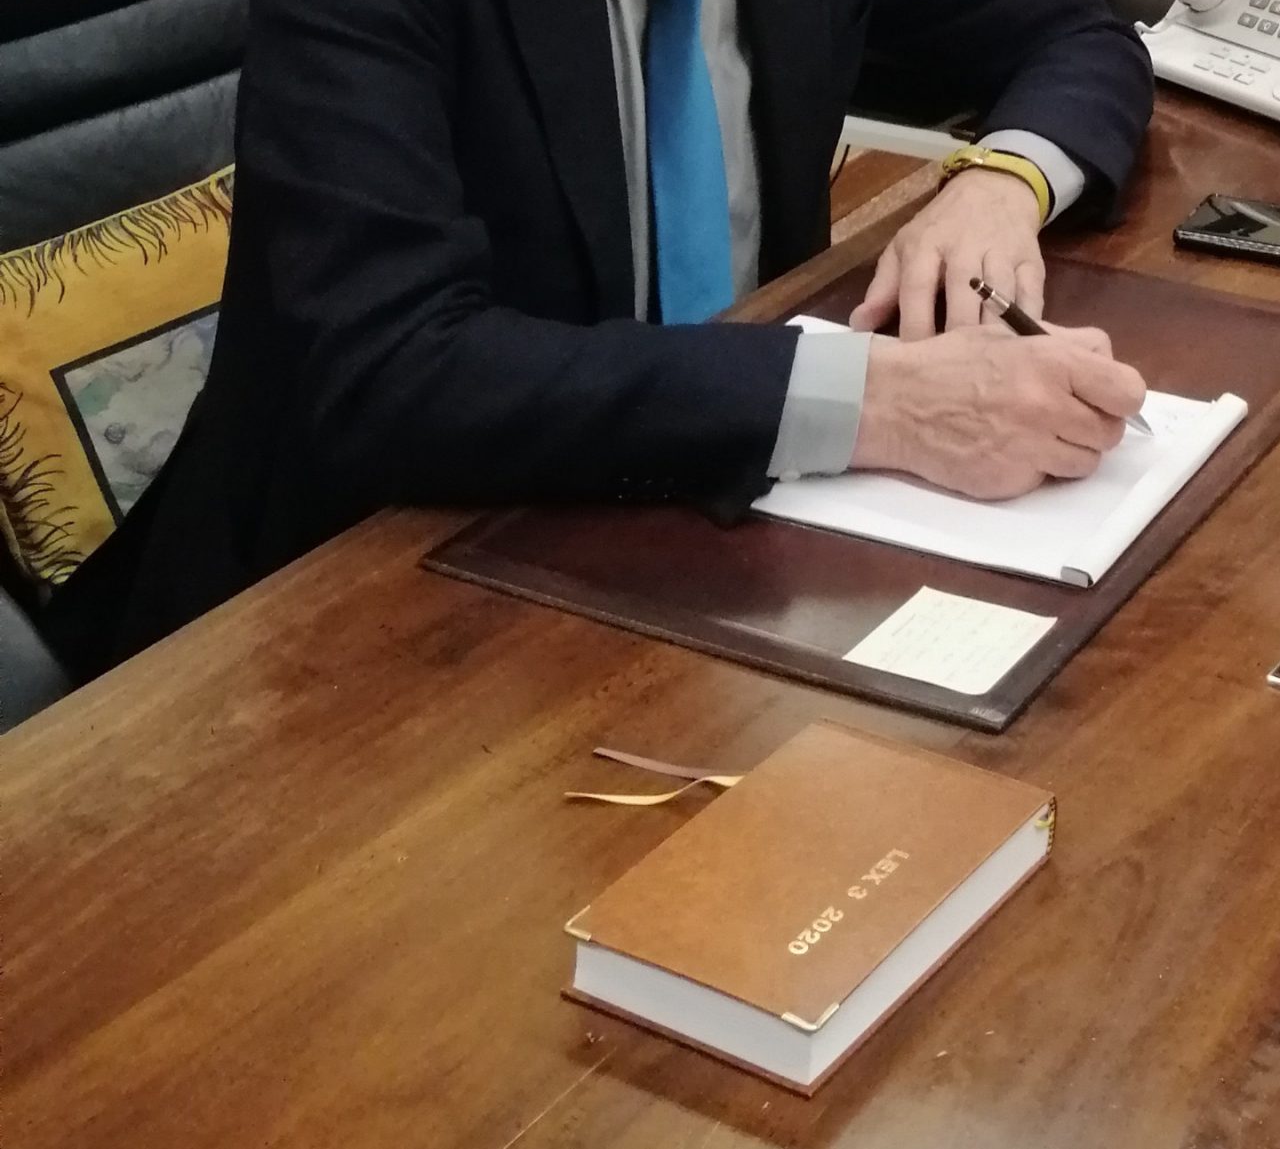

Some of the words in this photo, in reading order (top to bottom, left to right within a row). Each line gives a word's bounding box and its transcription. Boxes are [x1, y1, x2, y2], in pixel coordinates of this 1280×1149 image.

[861, 848, 910, 885] LEX
[847, 885, 868, 900] 3
[788, 905, 844, 954] 2020
